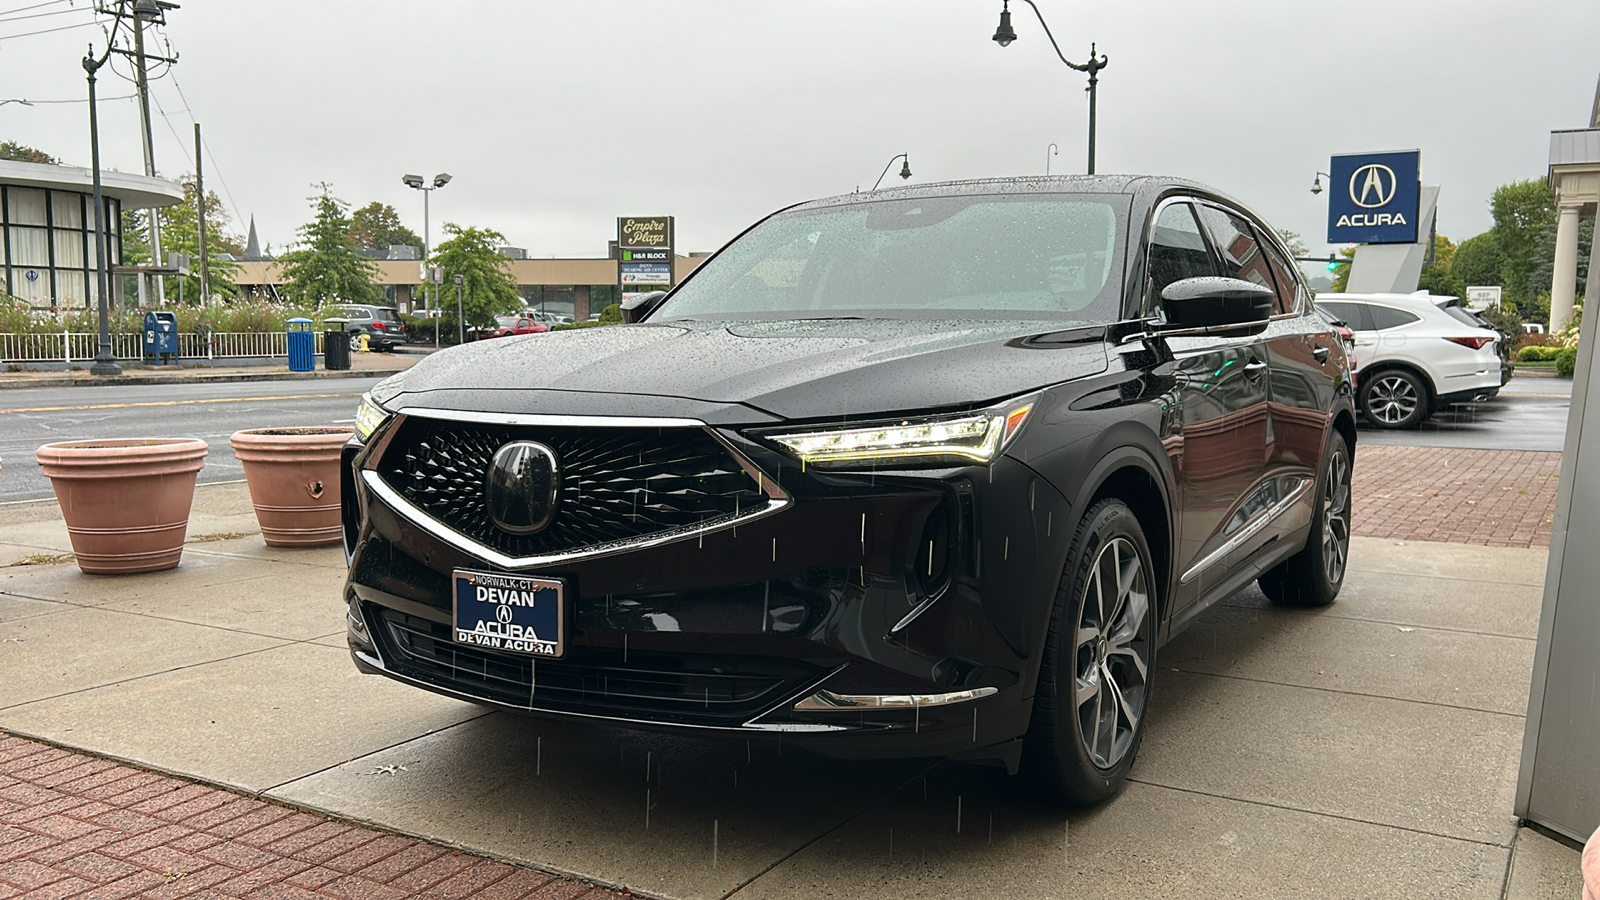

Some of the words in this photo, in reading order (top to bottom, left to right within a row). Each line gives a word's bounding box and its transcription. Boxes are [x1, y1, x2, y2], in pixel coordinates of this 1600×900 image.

[623, 219, 665, 234] Empire
[1336, 213, 1407, 227] ACURA
[628, 231, 665, 246] Plaza
[519, 580, 532, 590] CT
[476, 586, 535, 608] DEVAN
[474, 620, 538, 640] ACURA
[458, 632, 501, 648] DEVAN
[504, 639, 554, 655] ACURA
